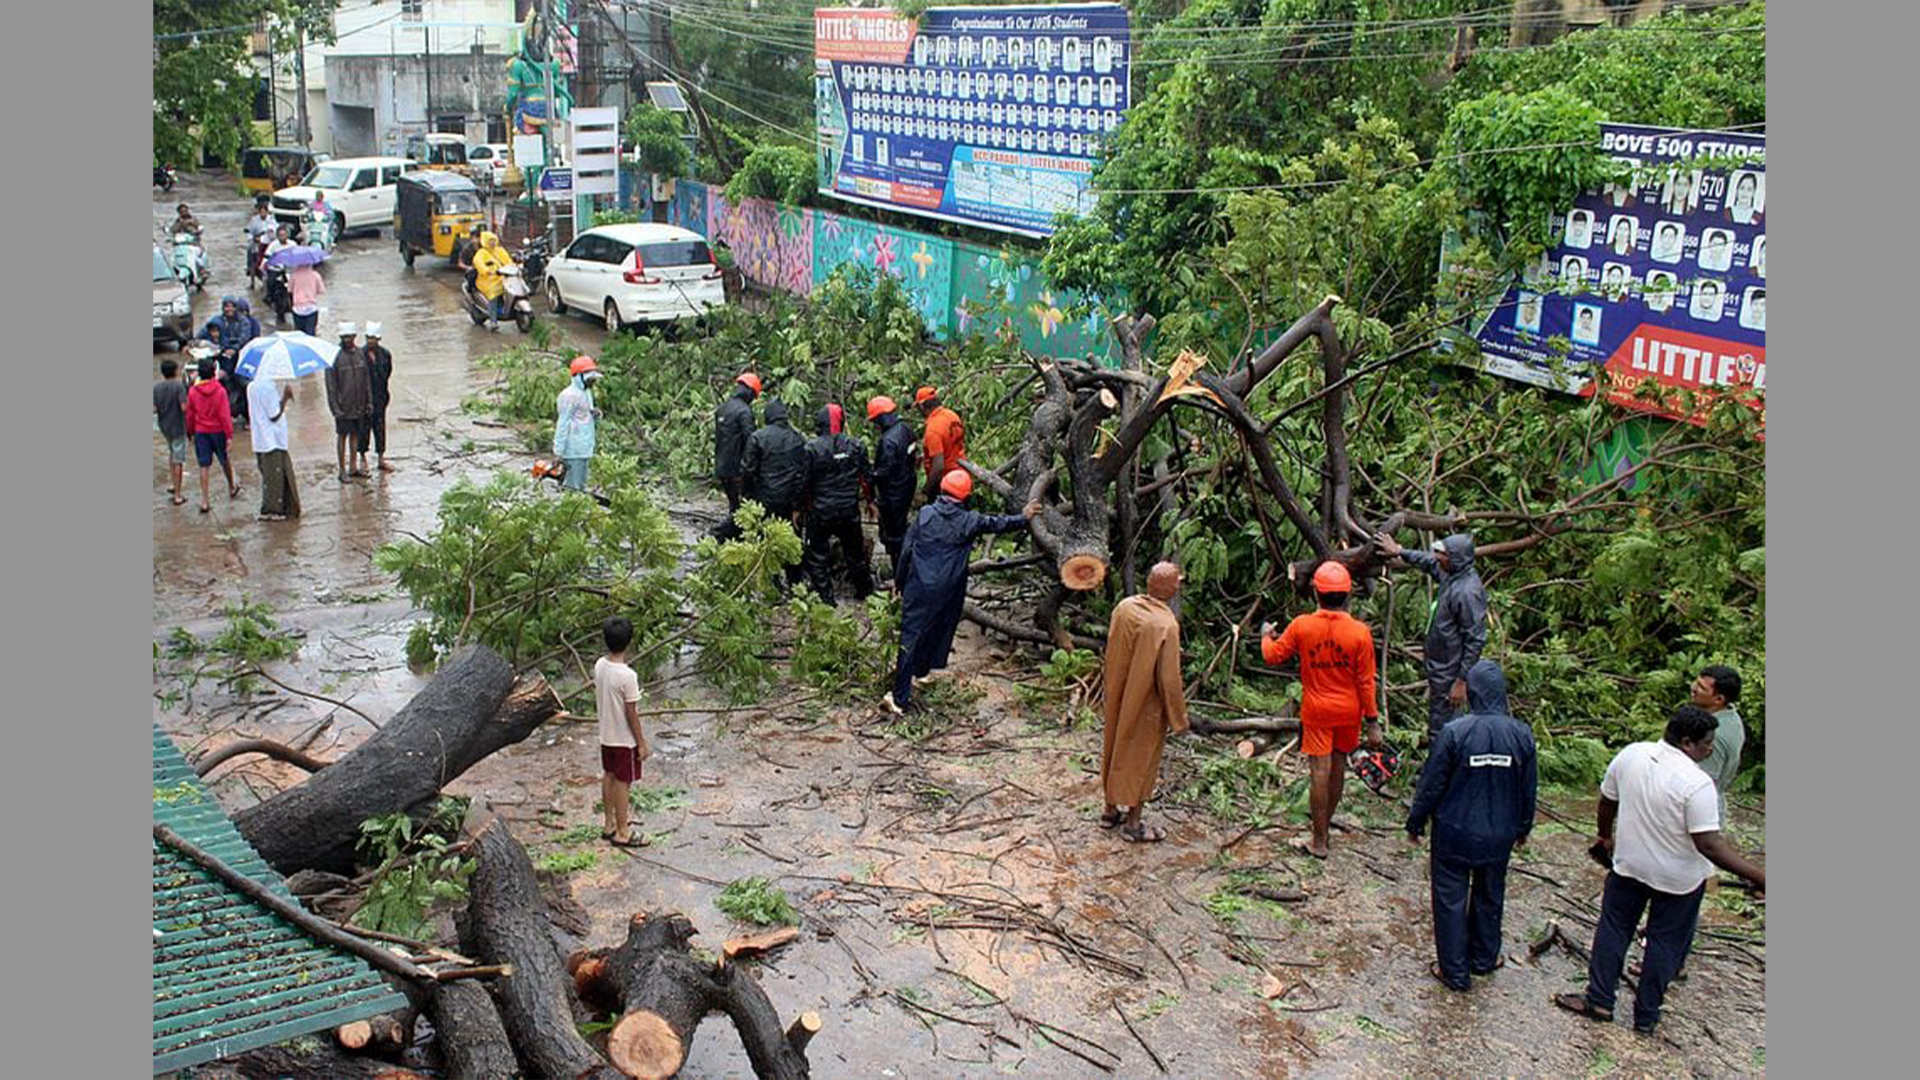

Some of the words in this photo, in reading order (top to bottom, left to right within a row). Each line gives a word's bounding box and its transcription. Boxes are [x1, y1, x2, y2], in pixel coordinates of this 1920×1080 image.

[816, 17, 852, 40] LITTLE
[858, 17, 908, 42] ANGELS
[1016, 16, 1032, 30] Our
[1053, 14, 1089, 30] Students
[1602, 132, 1653, 153] BOVE
[1656, 137, 1692, 157] 500
[1030, 157, 1056, 169] LITTLE
[1058, 159, 1091, 172] ANGELS
[1701, 175, 1725, 198] 570
[1632, 336, 1736, 386] LITTLE
